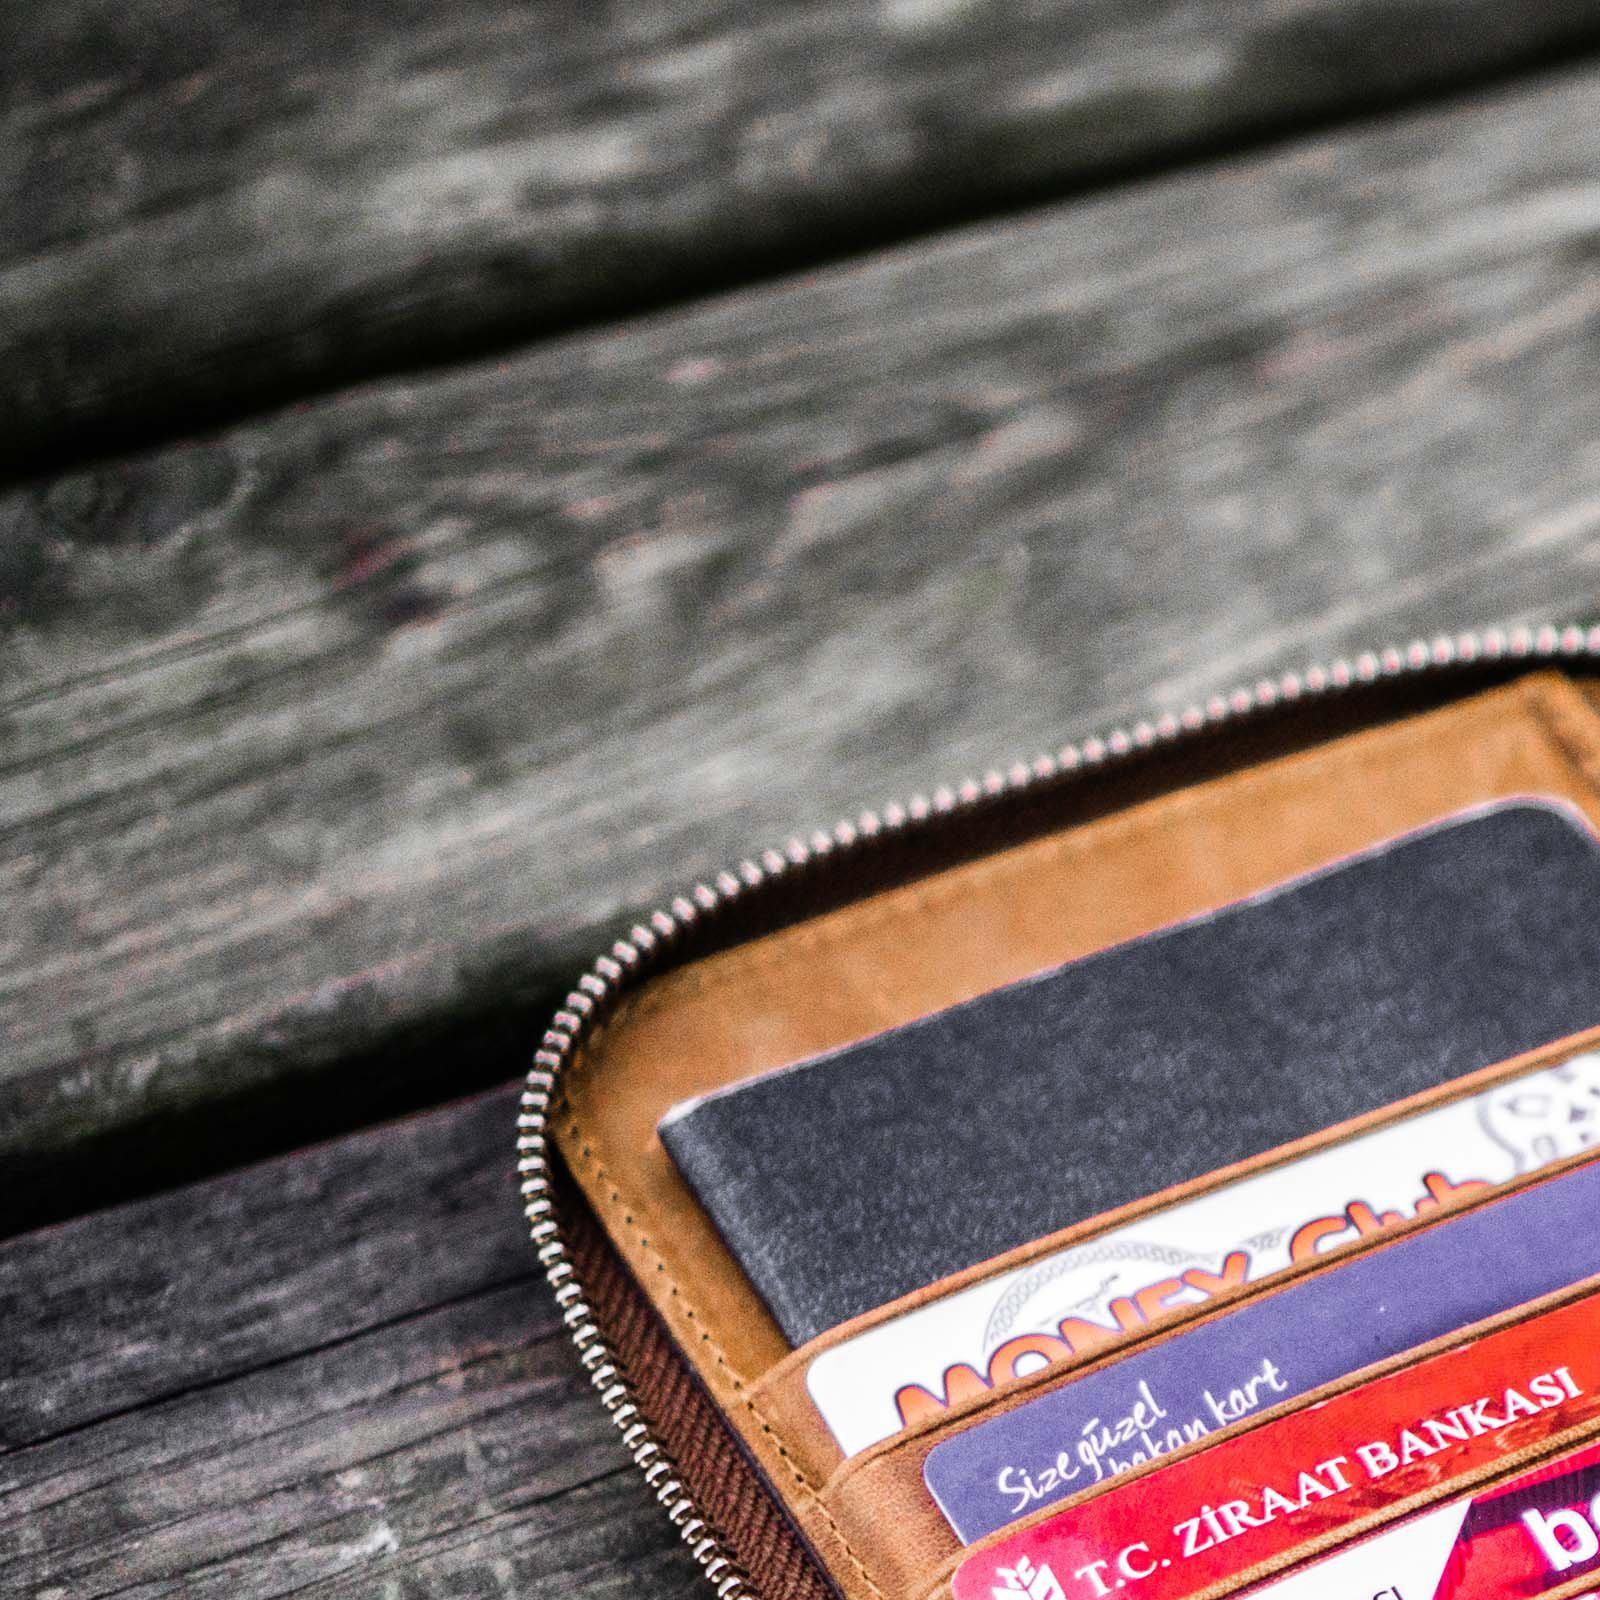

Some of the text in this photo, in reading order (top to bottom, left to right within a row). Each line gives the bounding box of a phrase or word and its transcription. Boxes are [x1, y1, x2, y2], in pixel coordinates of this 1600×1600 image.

[1204, 1358, 1289, 1427] kart
[998, 1452, 1080, 1514] Size
[1074, 1541, 1172, 1599] T.C.
[1355, 1365, 1586, 1479] BANKASI
